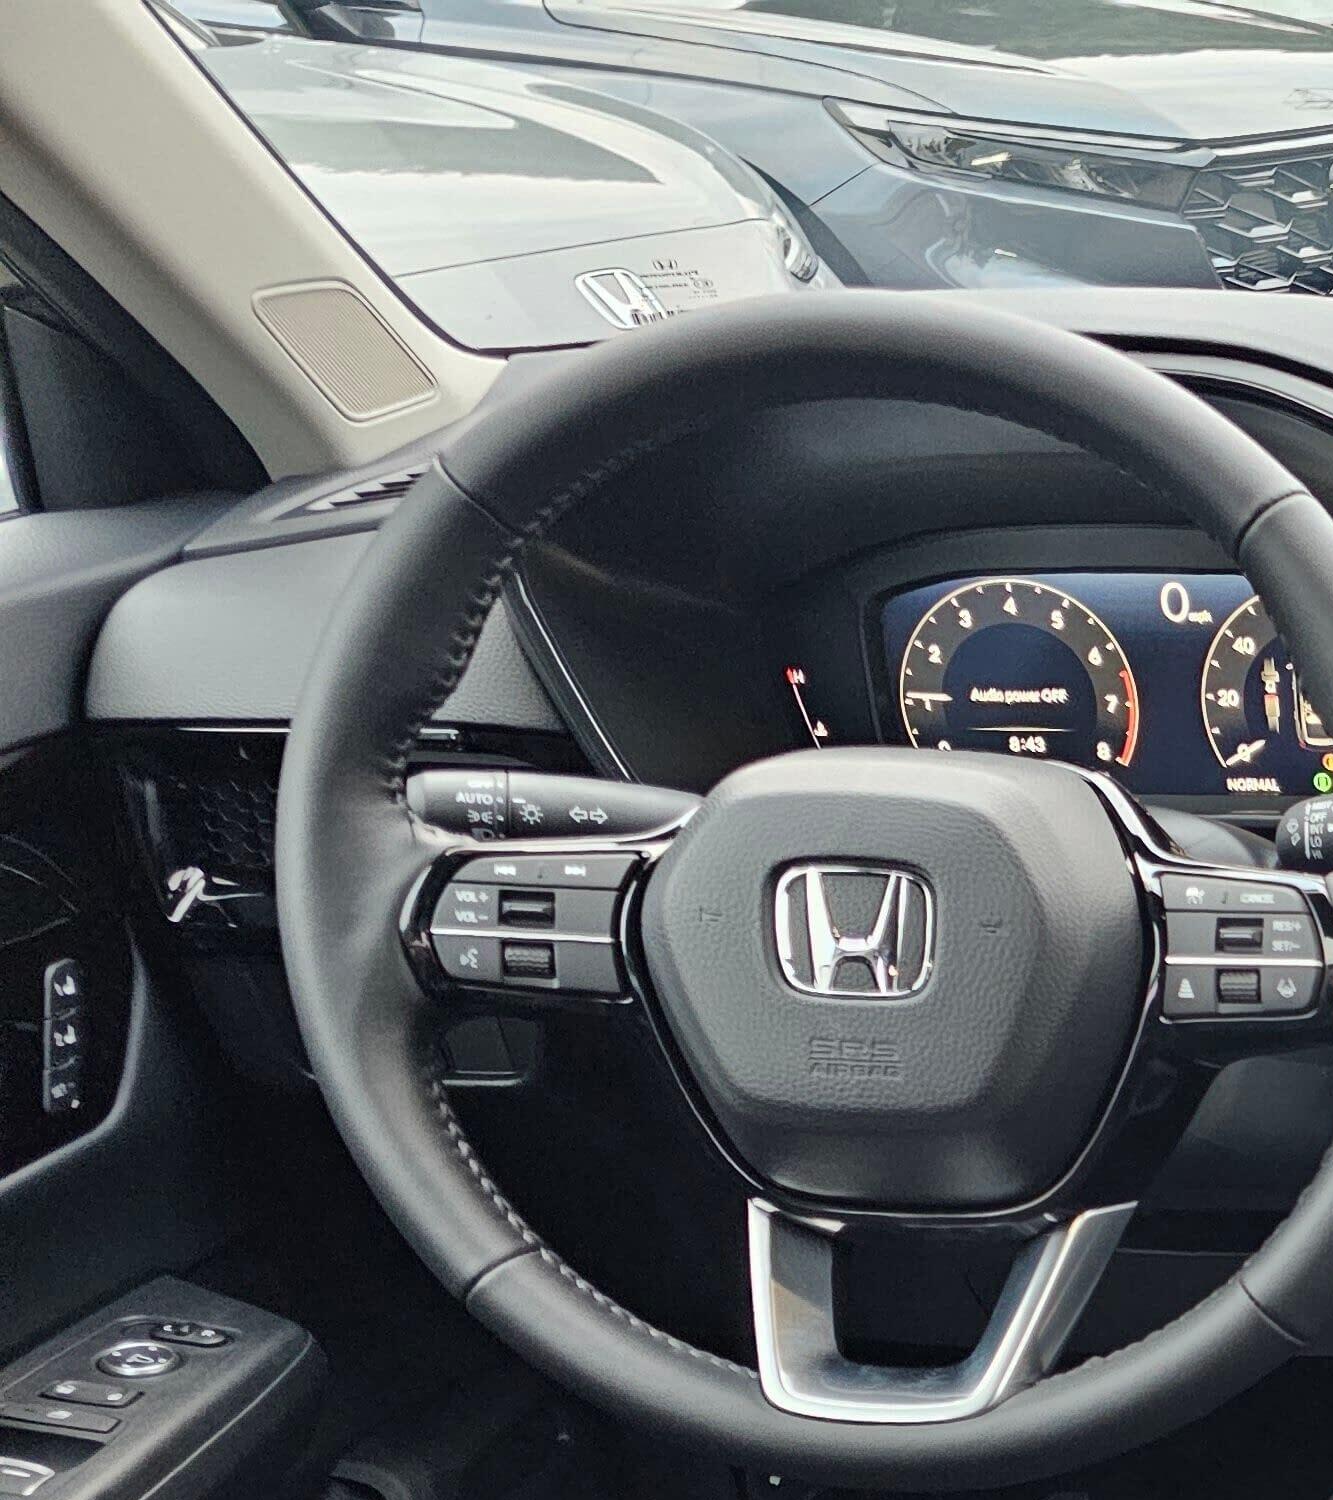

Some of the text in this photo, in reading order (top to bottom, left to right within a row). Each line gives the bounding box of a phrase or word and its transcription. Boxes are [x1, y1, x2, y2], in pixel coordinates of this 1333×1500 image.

[1002, 596, 1019, 616] 4
[1160, 581, 1190, 624] 0
[958, 608, 973, 629] 3
[1050, 609, 1065, 630] 5
[927, 643, 943, 664] 2
[1087, 645, 1104, 666] 6
[1231, 636, 1256, 656] 40
[969, 687, 1004, 704] Audio
[1040, 687, 1070, 704] OFF
[1104, 693, 1119, 714] 7
[1216, 688, 1240, 708] 20
[1008, 735, 1047, 753] 8:43
[1096, 741, 1112, 761] 8
[1225, 777, 1283, 794] NORMAL
[455, 791, 494, 806] AUTO
[1309, 811, 1328, 823] OFF
[1309, 836, 1323, 849] LO
